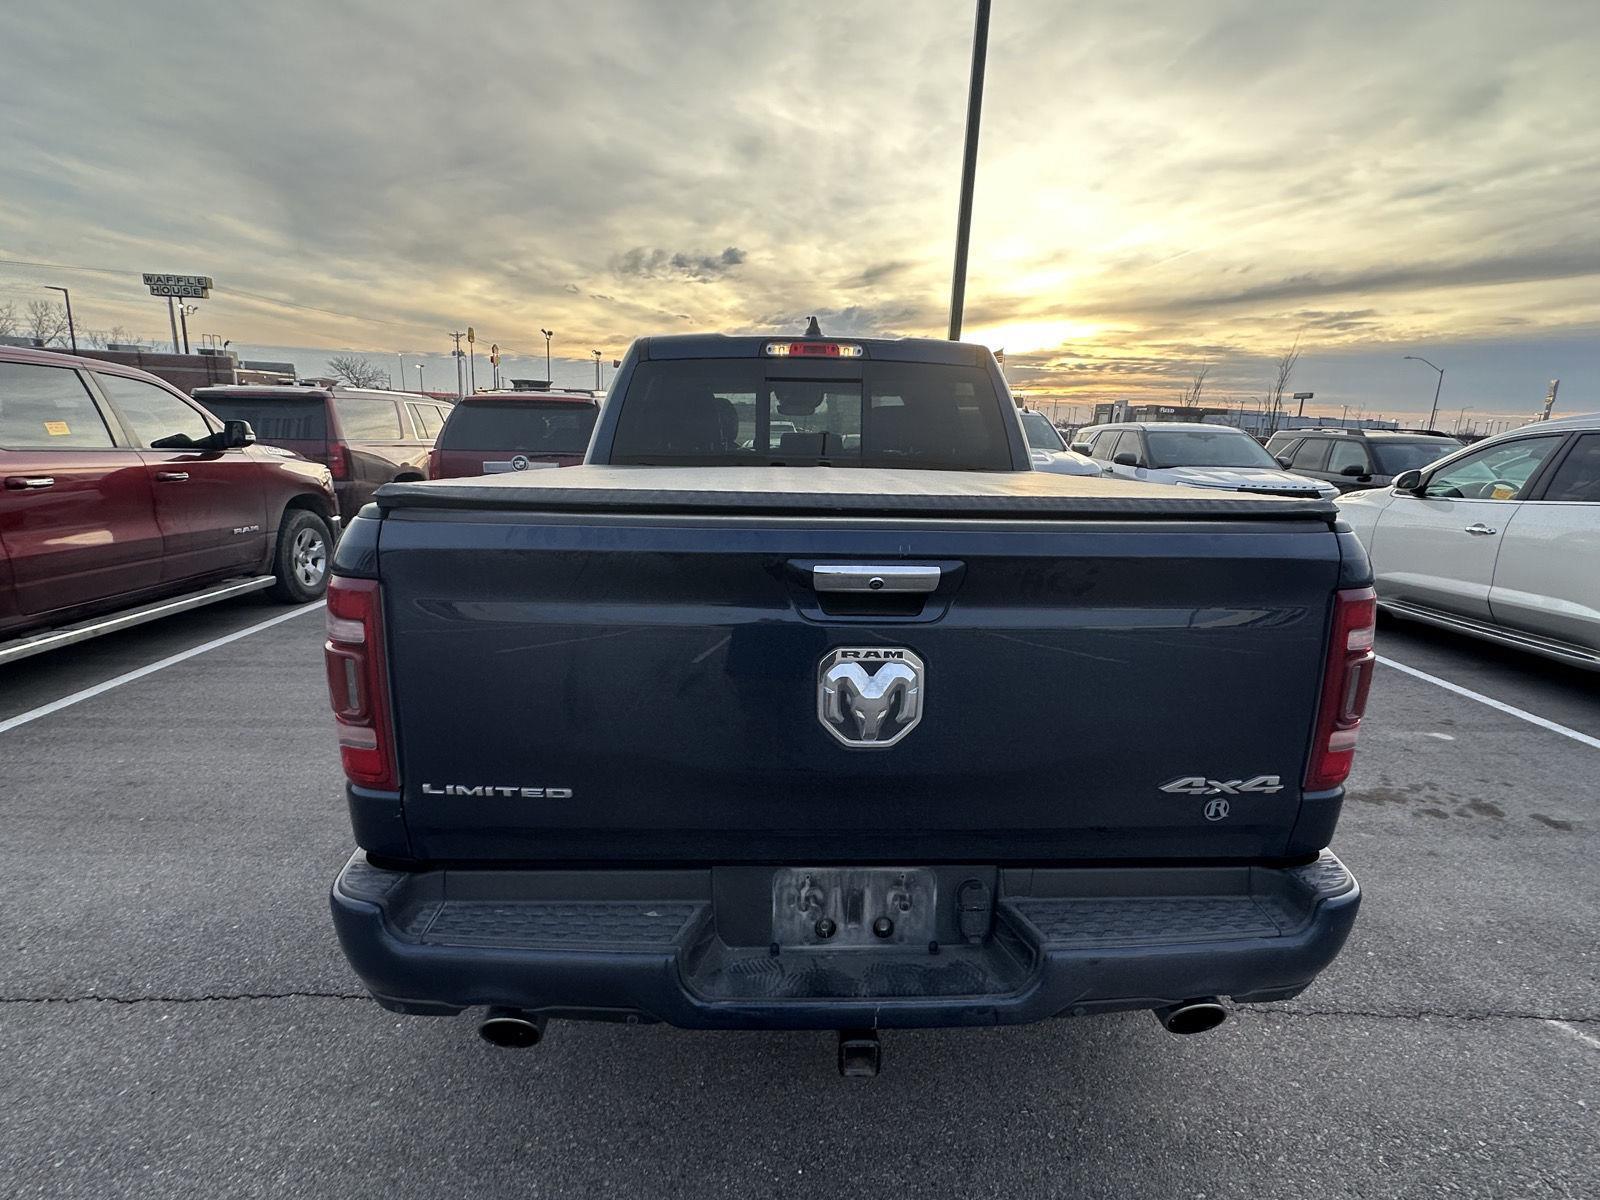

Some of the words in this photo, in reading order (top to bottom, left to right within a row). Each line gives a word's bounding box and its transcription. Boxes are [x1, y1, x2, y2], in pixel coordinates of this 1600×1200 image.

[143, 274, 206, 286] WAFFLE
[151, 286, 201, 296] HOUSE
[840, 650, 904, 659] RAM
[422, 783, 573, 798] LIMITED
